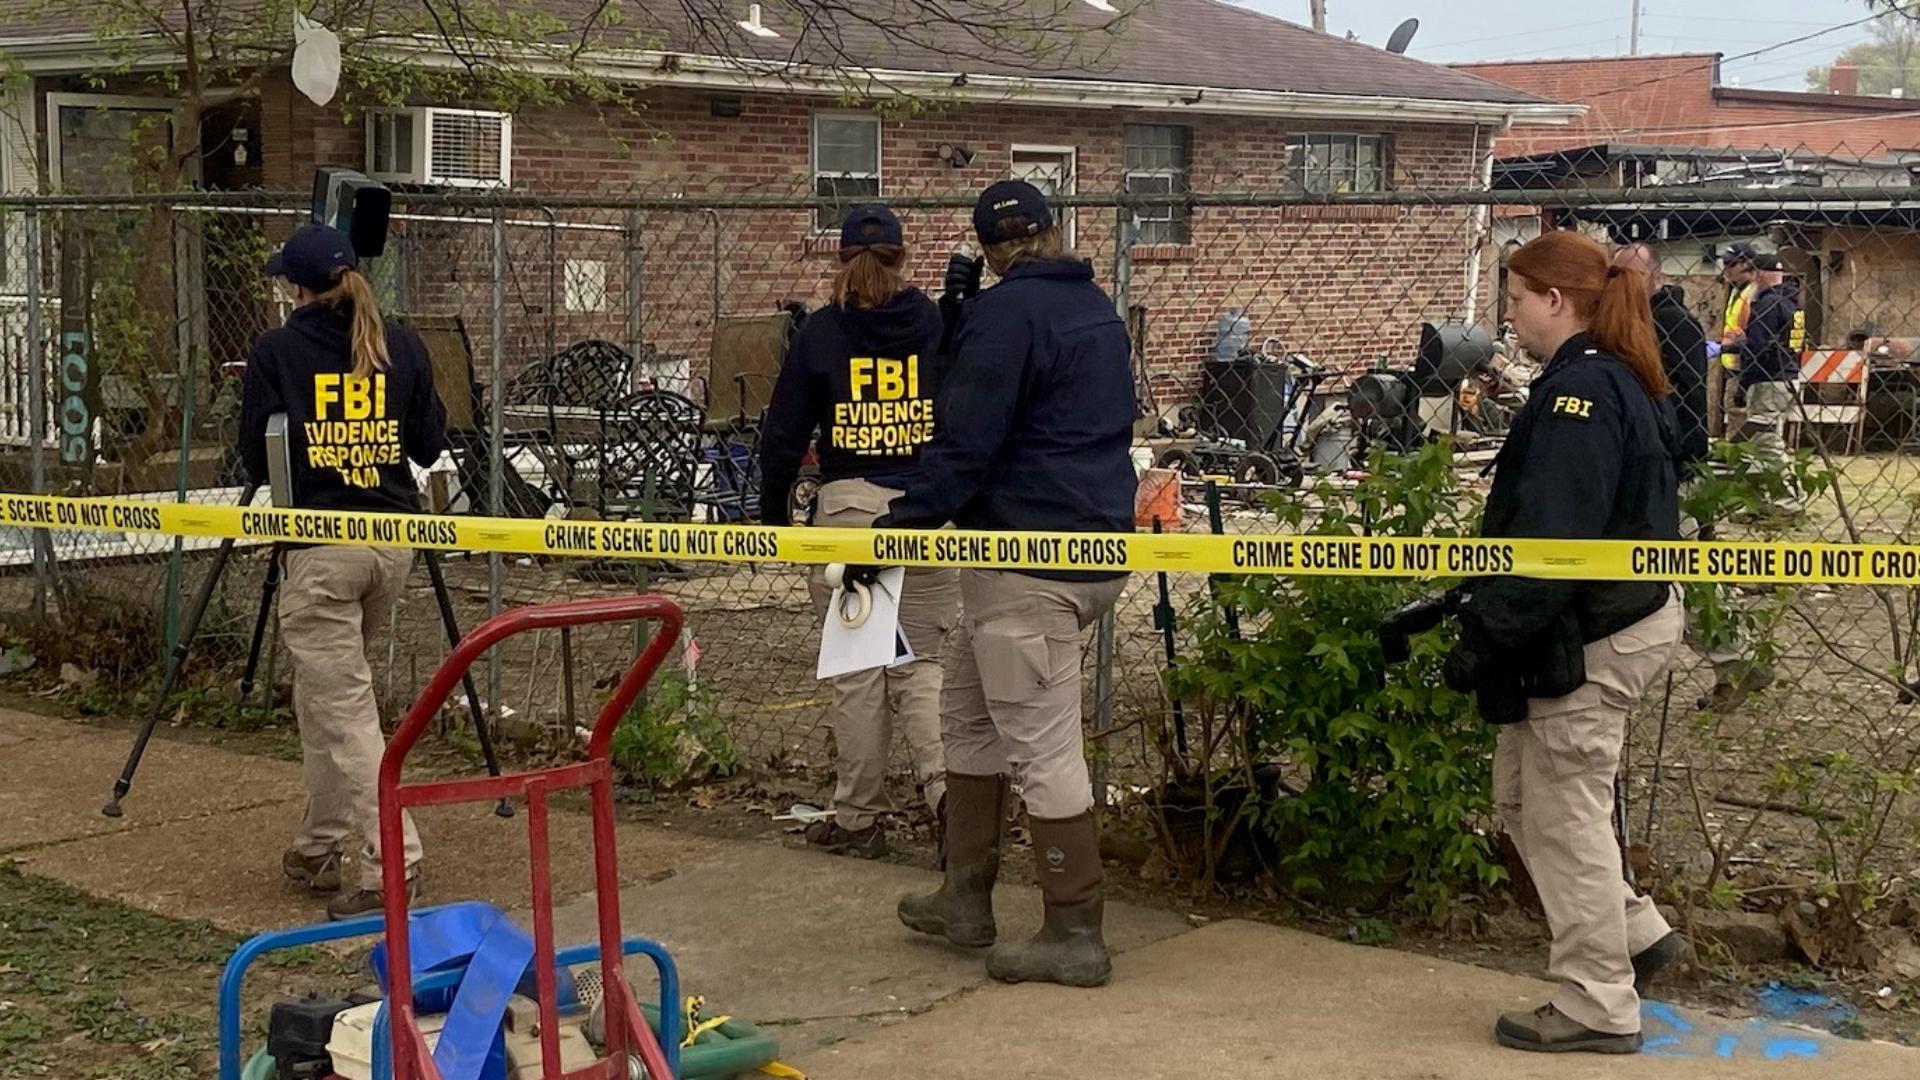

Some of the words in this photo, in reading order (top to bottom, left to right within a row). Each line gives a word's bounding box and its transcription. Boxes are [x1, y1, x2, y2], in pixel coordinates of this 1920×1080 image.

[849, 354, 919, 401] FBI
[315, 373, 386, 421] FBI
[835, 399, 934, 425] EVIDENCE
[1552, 396, 1594, 418] FBI
[832, 421, 935, 449] RESPONSE
[7, 498, 55, 524] SCENE
[56, 502, 77, 525] DO
[80, 503, 108, 527] NOT
[112, 505, 161, 531] CROSS
[242, 512, 291, 537] CRIME
[294, 514, 343, 539] SCENE
[347, 517, 368, 541] DO
[372, 518, 402, 542] NOT
[406, 519, 457, 545] CROSS
[545, 524, 597, 551] CRIME
[602, 526, 653, 553] SCENE
[659, 529, 680, 554] DO
[686, 530, 718, 555] NOT
[723, 530, 778, 557] CROSS
[873, 534, 930, 561] CRIME
[935, 536, 991, 562] SCENE
[997, 537, 1021, 563] DO
[1027, 538, 1062, 564] NOT
[1067, 538, 1127, 566] CROSS
[1233, 540, 1294, 568] CRIME
[1301, 541, 1362, 569] SCENE
[1369, 542, 1395, 570] DO
[1402, 543, 1441, 571] NOT
[1447, 543, 1514, 573] CROSS
[1632, 546, 1700, 575] CRIME
[1707, 548, 1776, 576] SCENE
[1784, 549, 1813, 577] DO
[1821, 550, 1864, 578] NOT
[1871, 550, 1920, 578] CRO
